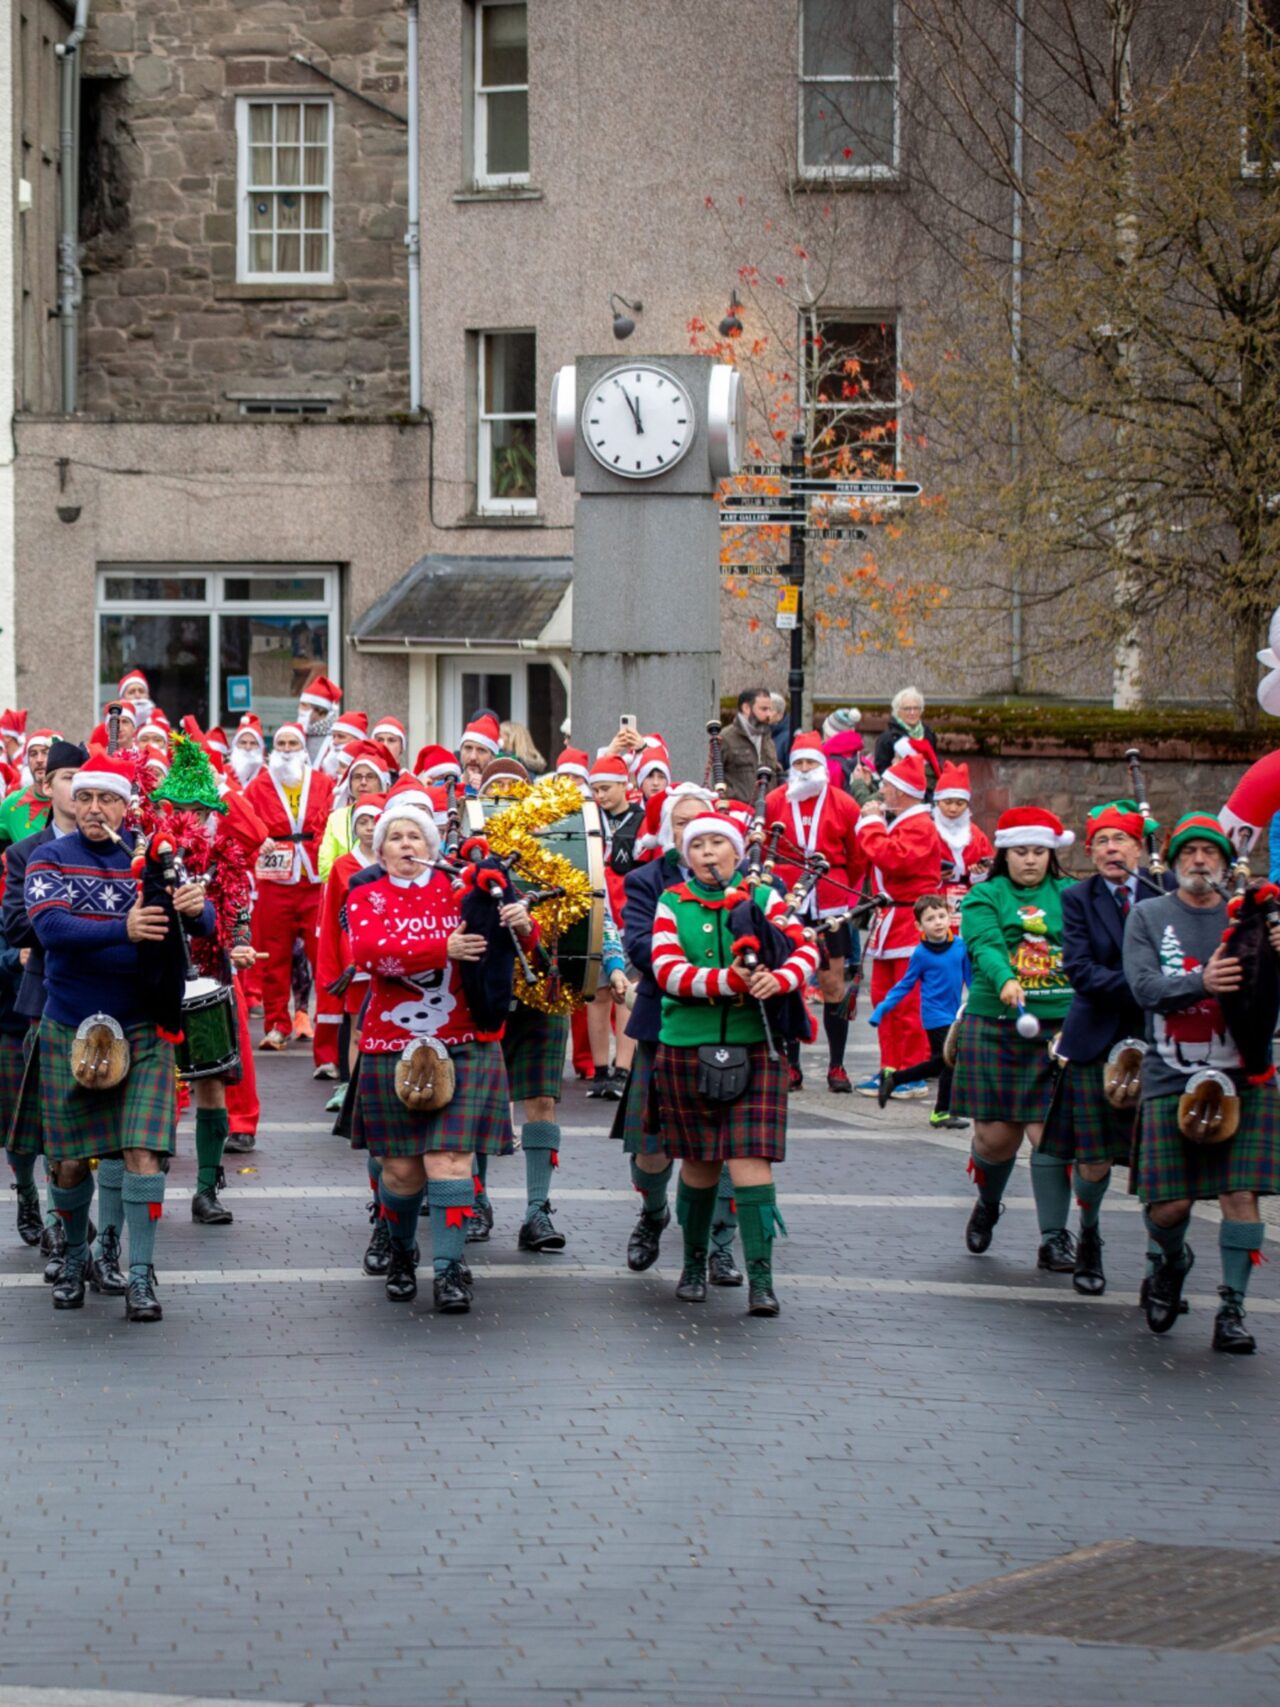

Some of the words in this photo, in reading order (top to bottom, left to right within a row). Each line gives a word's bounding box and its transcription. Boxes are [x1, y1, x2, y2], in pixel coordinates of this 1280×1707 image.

[836, 484, 860, 492] PERTH
[861, 484, 893, 493] MUSEUM
[723, 513, 738, 521] ART
[739, 513, 770, 522] GALLERY
[264, 854, 284, 867] 237
